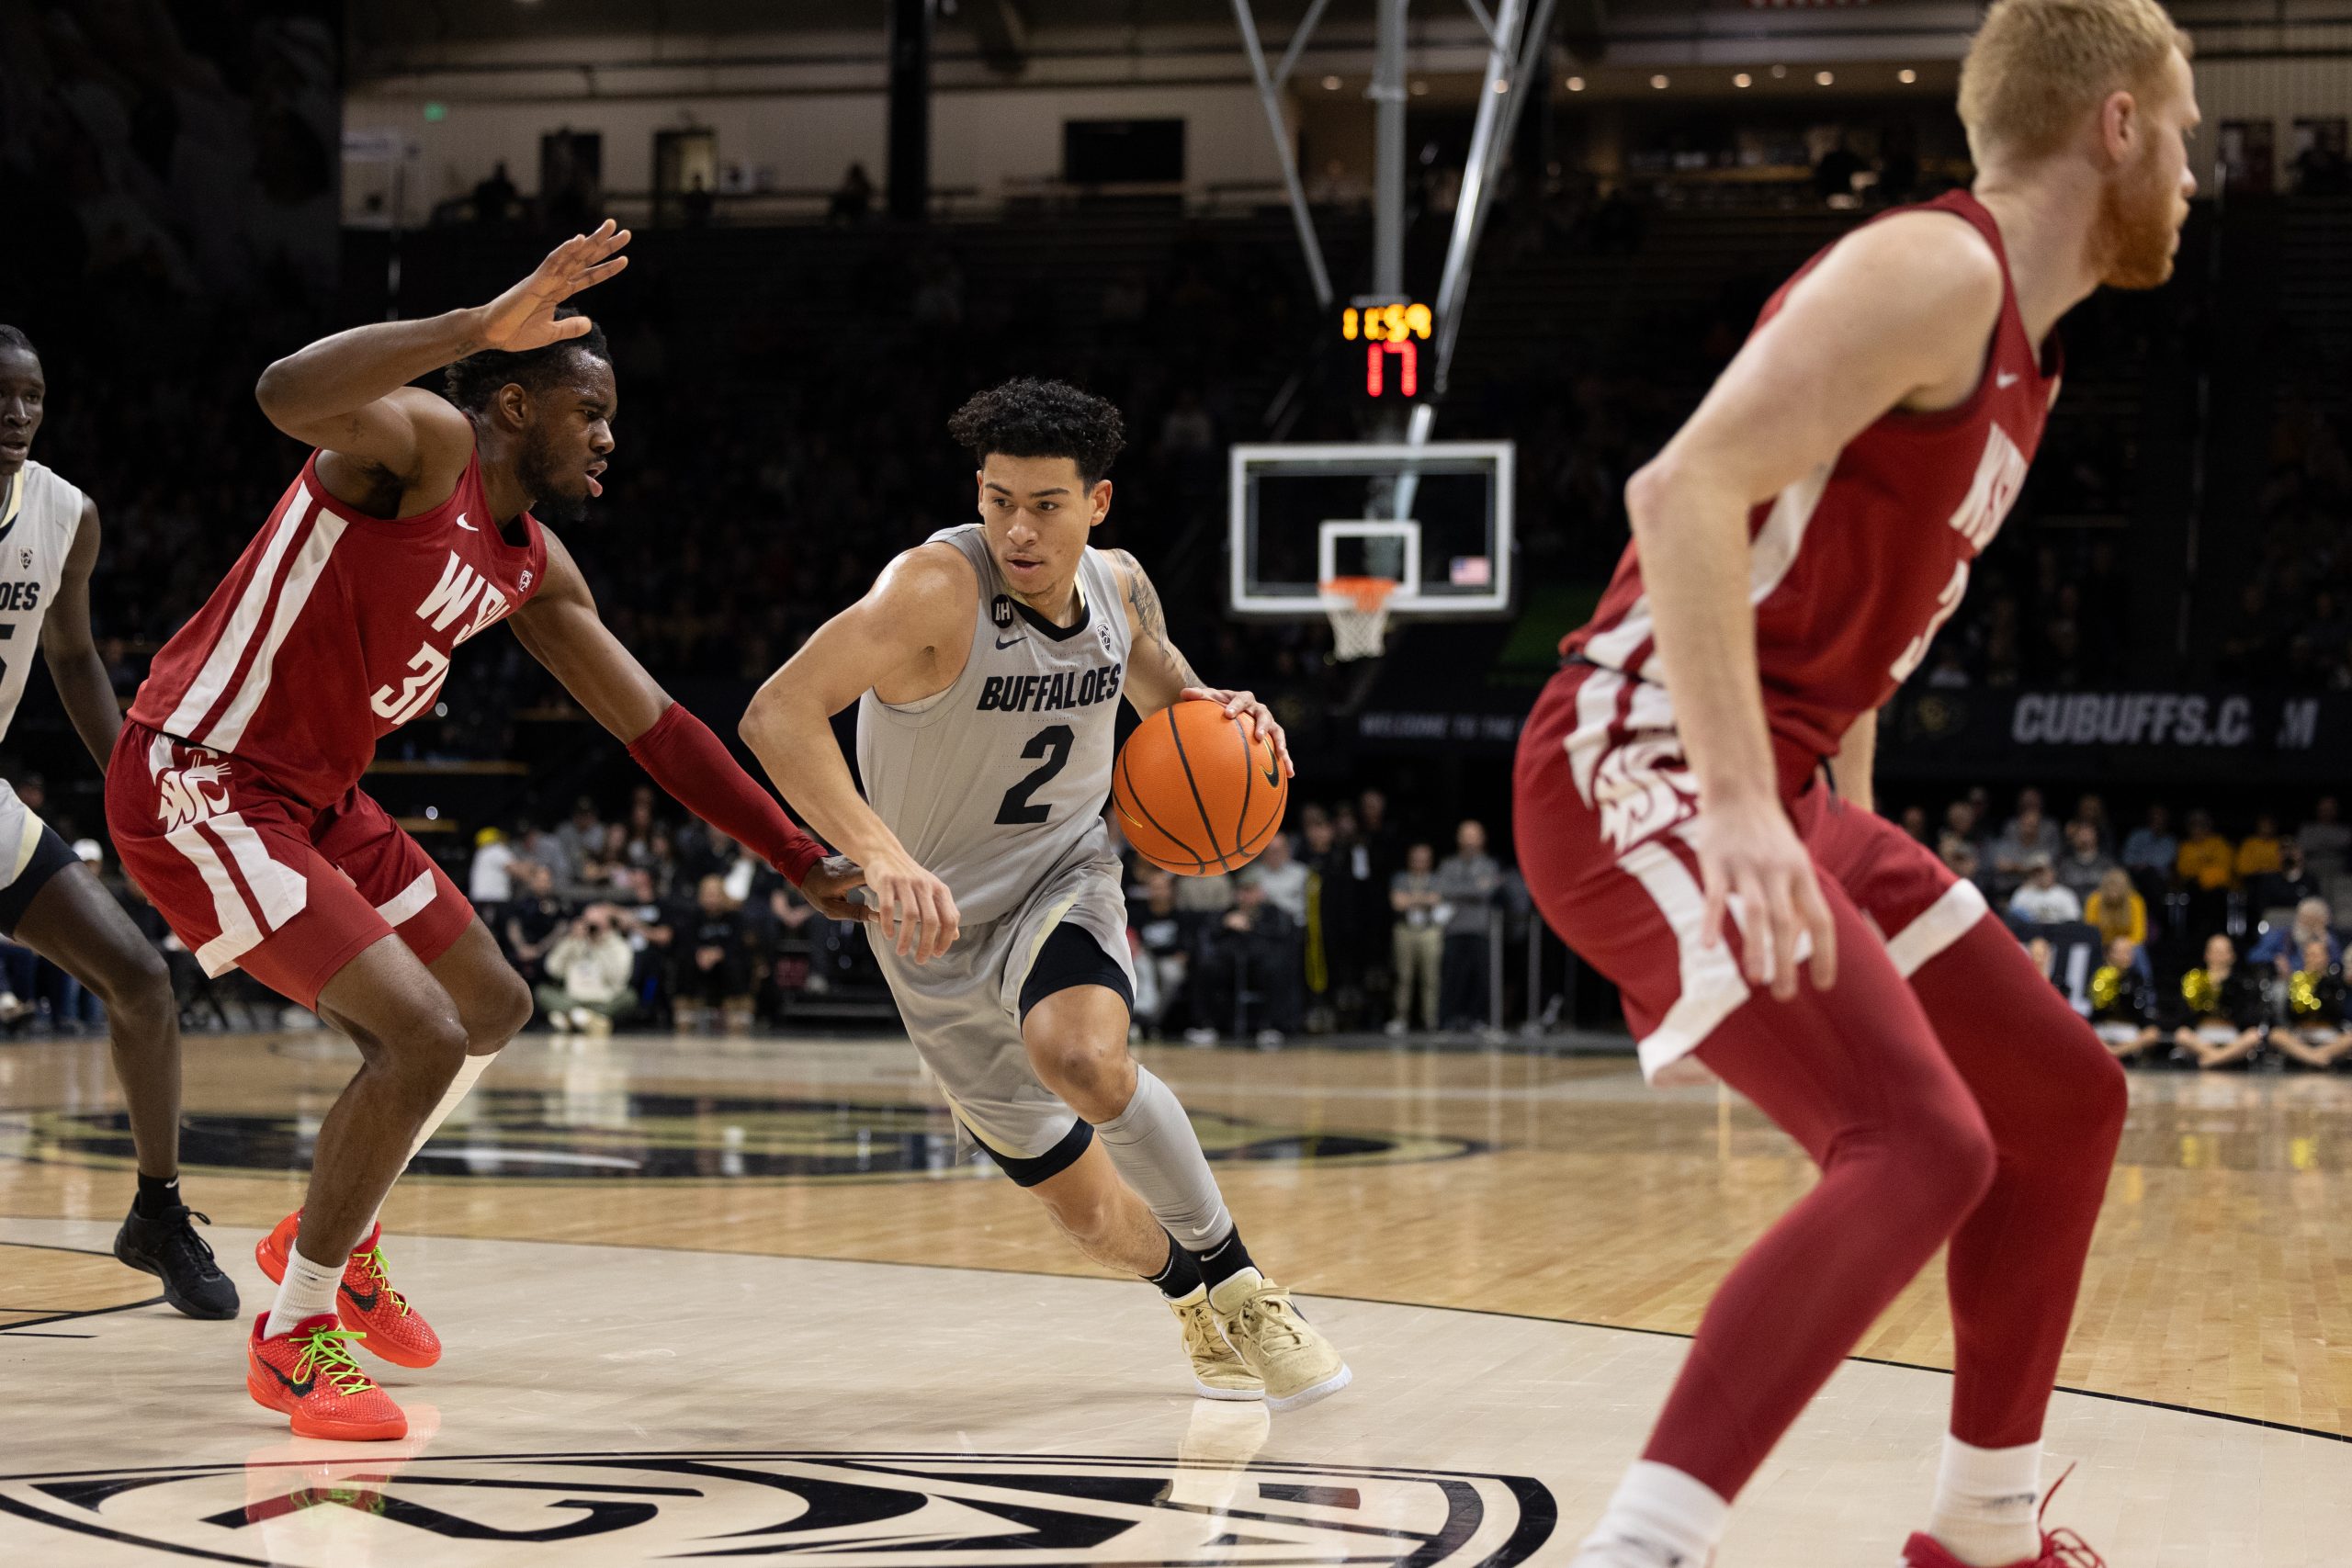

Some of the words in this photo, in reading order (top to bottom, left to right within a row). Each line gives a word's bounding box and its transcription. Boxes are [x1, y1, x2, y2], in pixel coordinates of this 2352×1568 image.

[1367, 340, 1417, 397] 17
[977, 663, 1122, 712] BUFFALOES
[2012, 692, 2318, 749] CUBUFFS.CM
[994, 725, 1075, 824] 2
